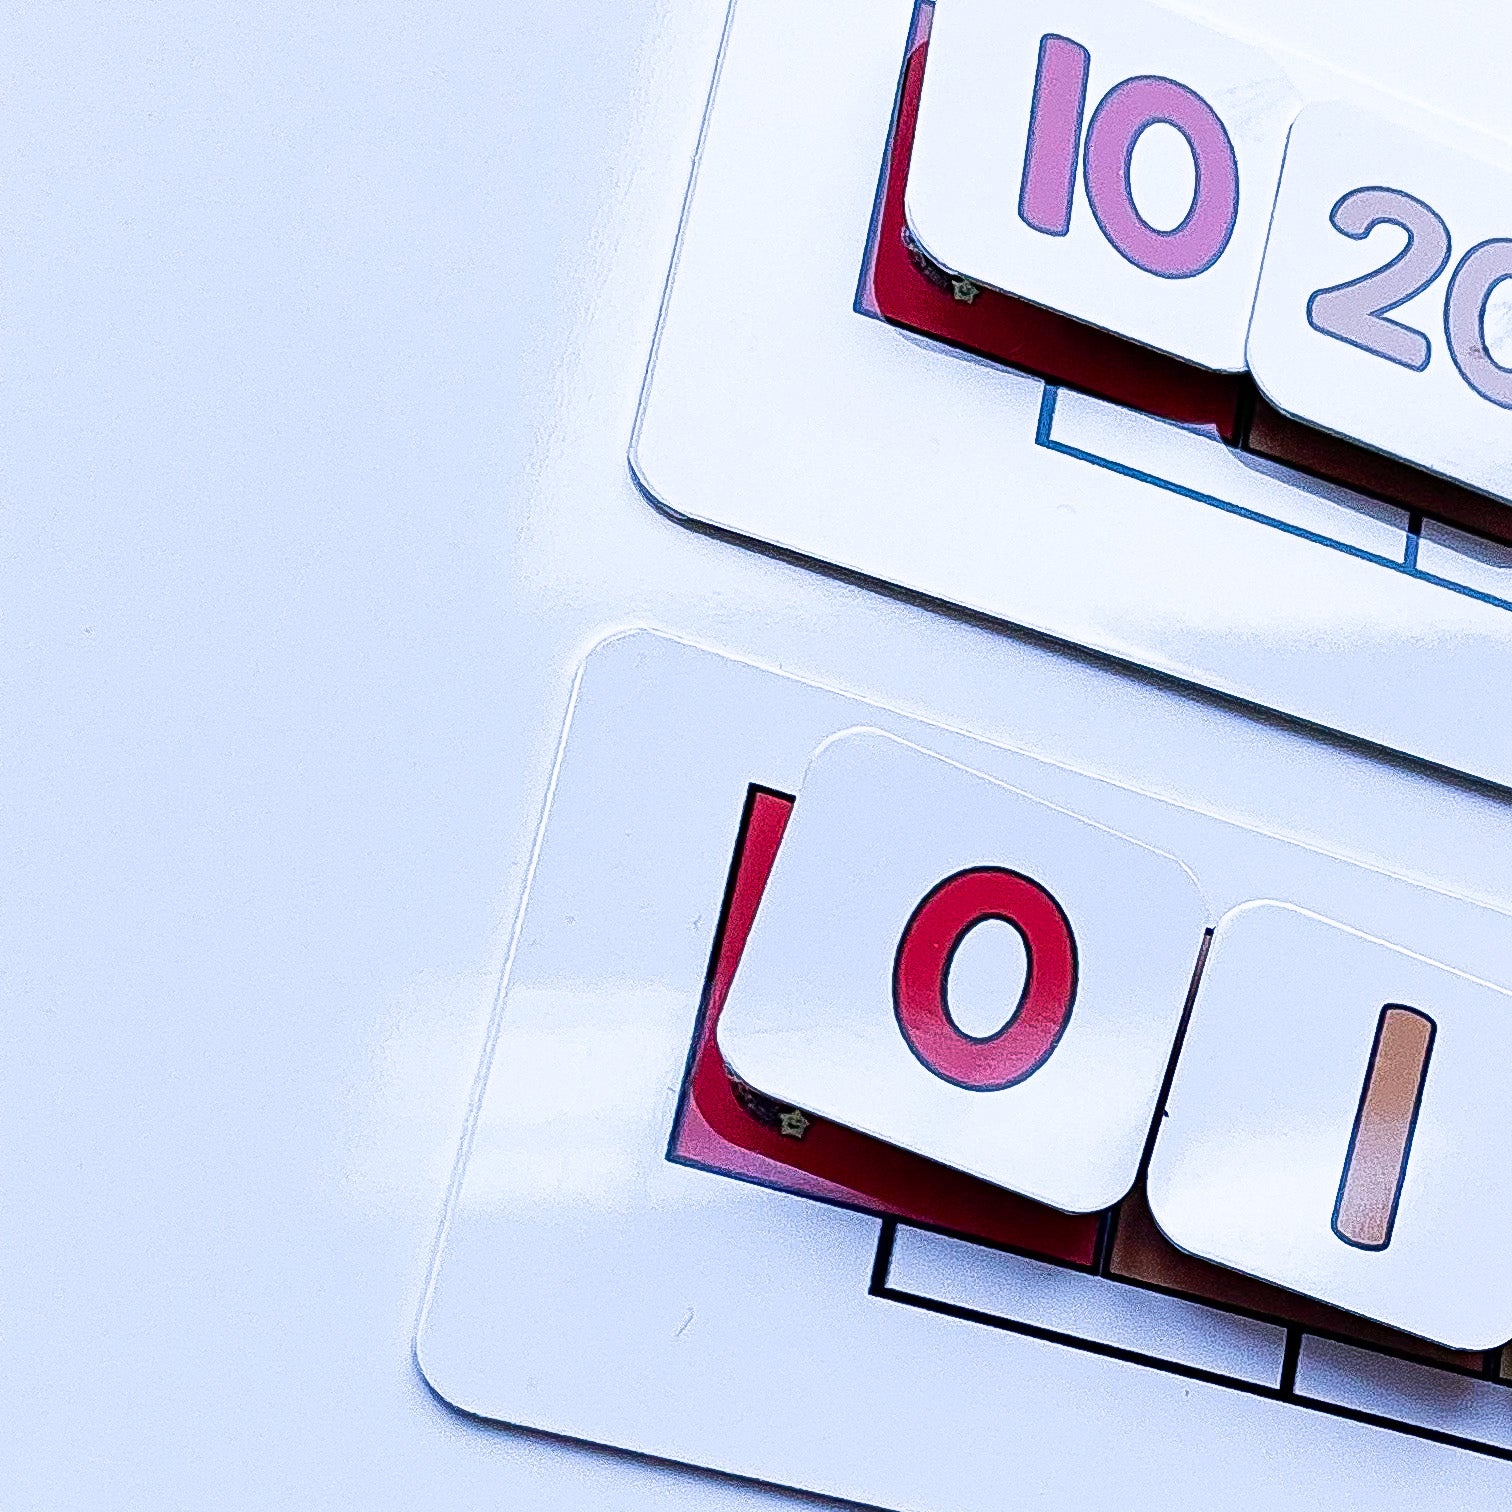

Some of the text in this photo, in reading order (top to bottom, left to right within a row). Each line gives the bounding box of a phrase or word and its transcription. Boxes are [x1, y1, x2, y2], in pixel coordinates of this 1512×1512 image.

[1018, 33, 1239, 280] 10
[892, 866, 1079, 1092] 0
[1331, 1003, 1437, 1252] 1
